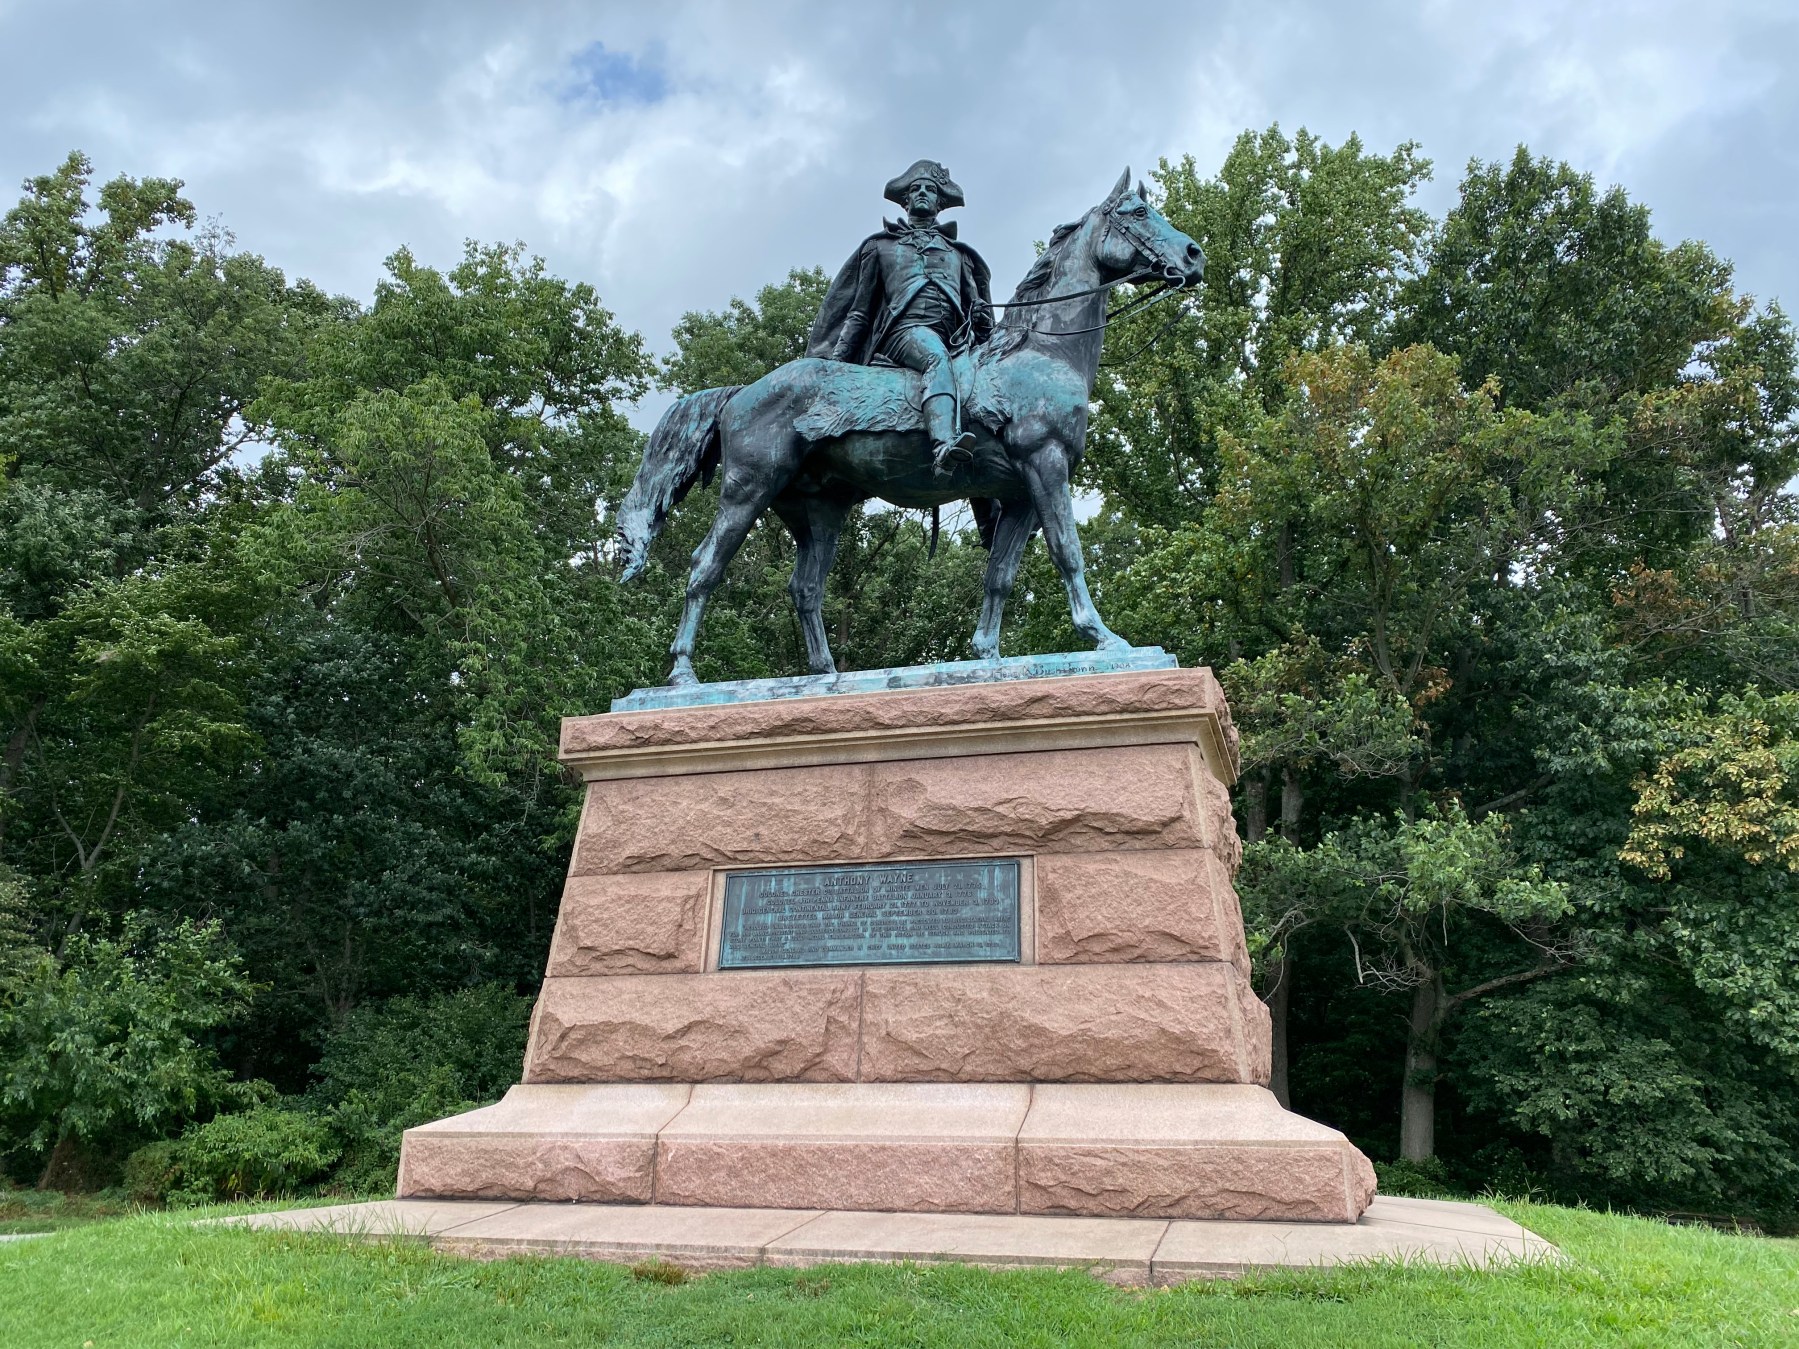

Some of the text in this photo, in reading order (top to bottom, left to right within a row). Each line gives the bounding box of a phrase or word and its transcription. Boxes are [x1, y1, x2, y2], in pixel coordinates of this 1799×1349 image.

[823, 872, 914, 886] ANTHONY WAYNE
[791, 888, 821, 896] CHESTER
[885, 884, 910, 892] MINUTE
[932, 882, 949, 890] JULY
[871, 892, 906, 901] BATTALION
[911, 891, 942, 899] JANUARY
[757, 905, 786, 913] GENERAL
[788, 904, 829, 912] CONTINENTAL
[853, 902, 886, 910] FEBRUARY
[933, 898, 970, 907] NOVEMBER
[881, 908, 923, 917] SEPTEMBER
